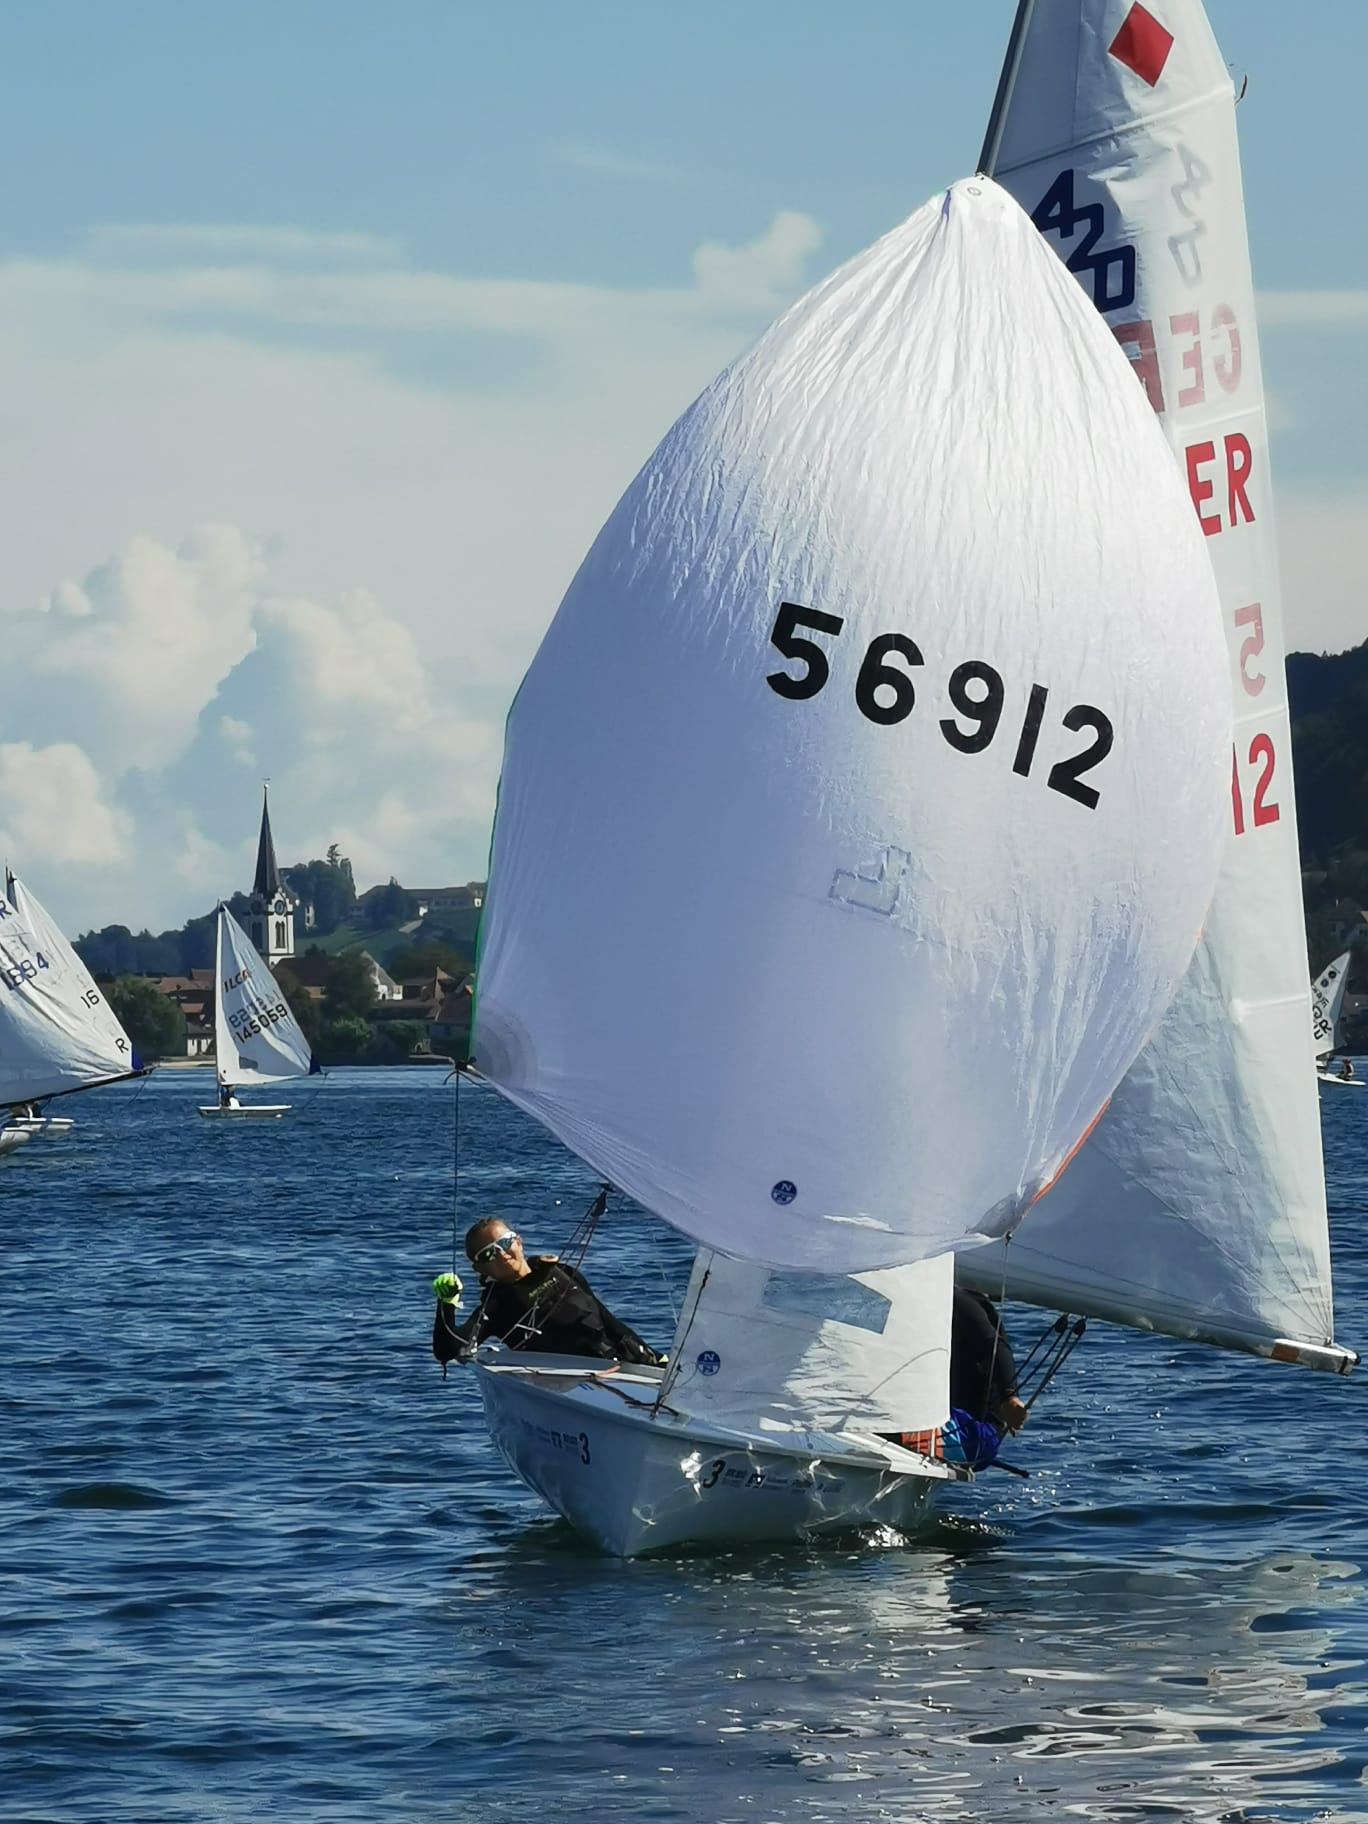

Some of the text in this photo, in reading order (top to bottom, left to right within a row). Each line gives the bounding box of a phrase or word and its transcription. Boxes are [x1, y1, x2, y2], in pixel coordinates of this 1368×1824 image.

[1031, 169, 1136, 313] 420
[765, 601, 1114, 811] 56912
[80, 989, 100, 1009] 16
[235, 1003, 288, 1044] 145059
[578, 1431, 591, 1466] 3
[702, 1459, 727, 1489] 3
